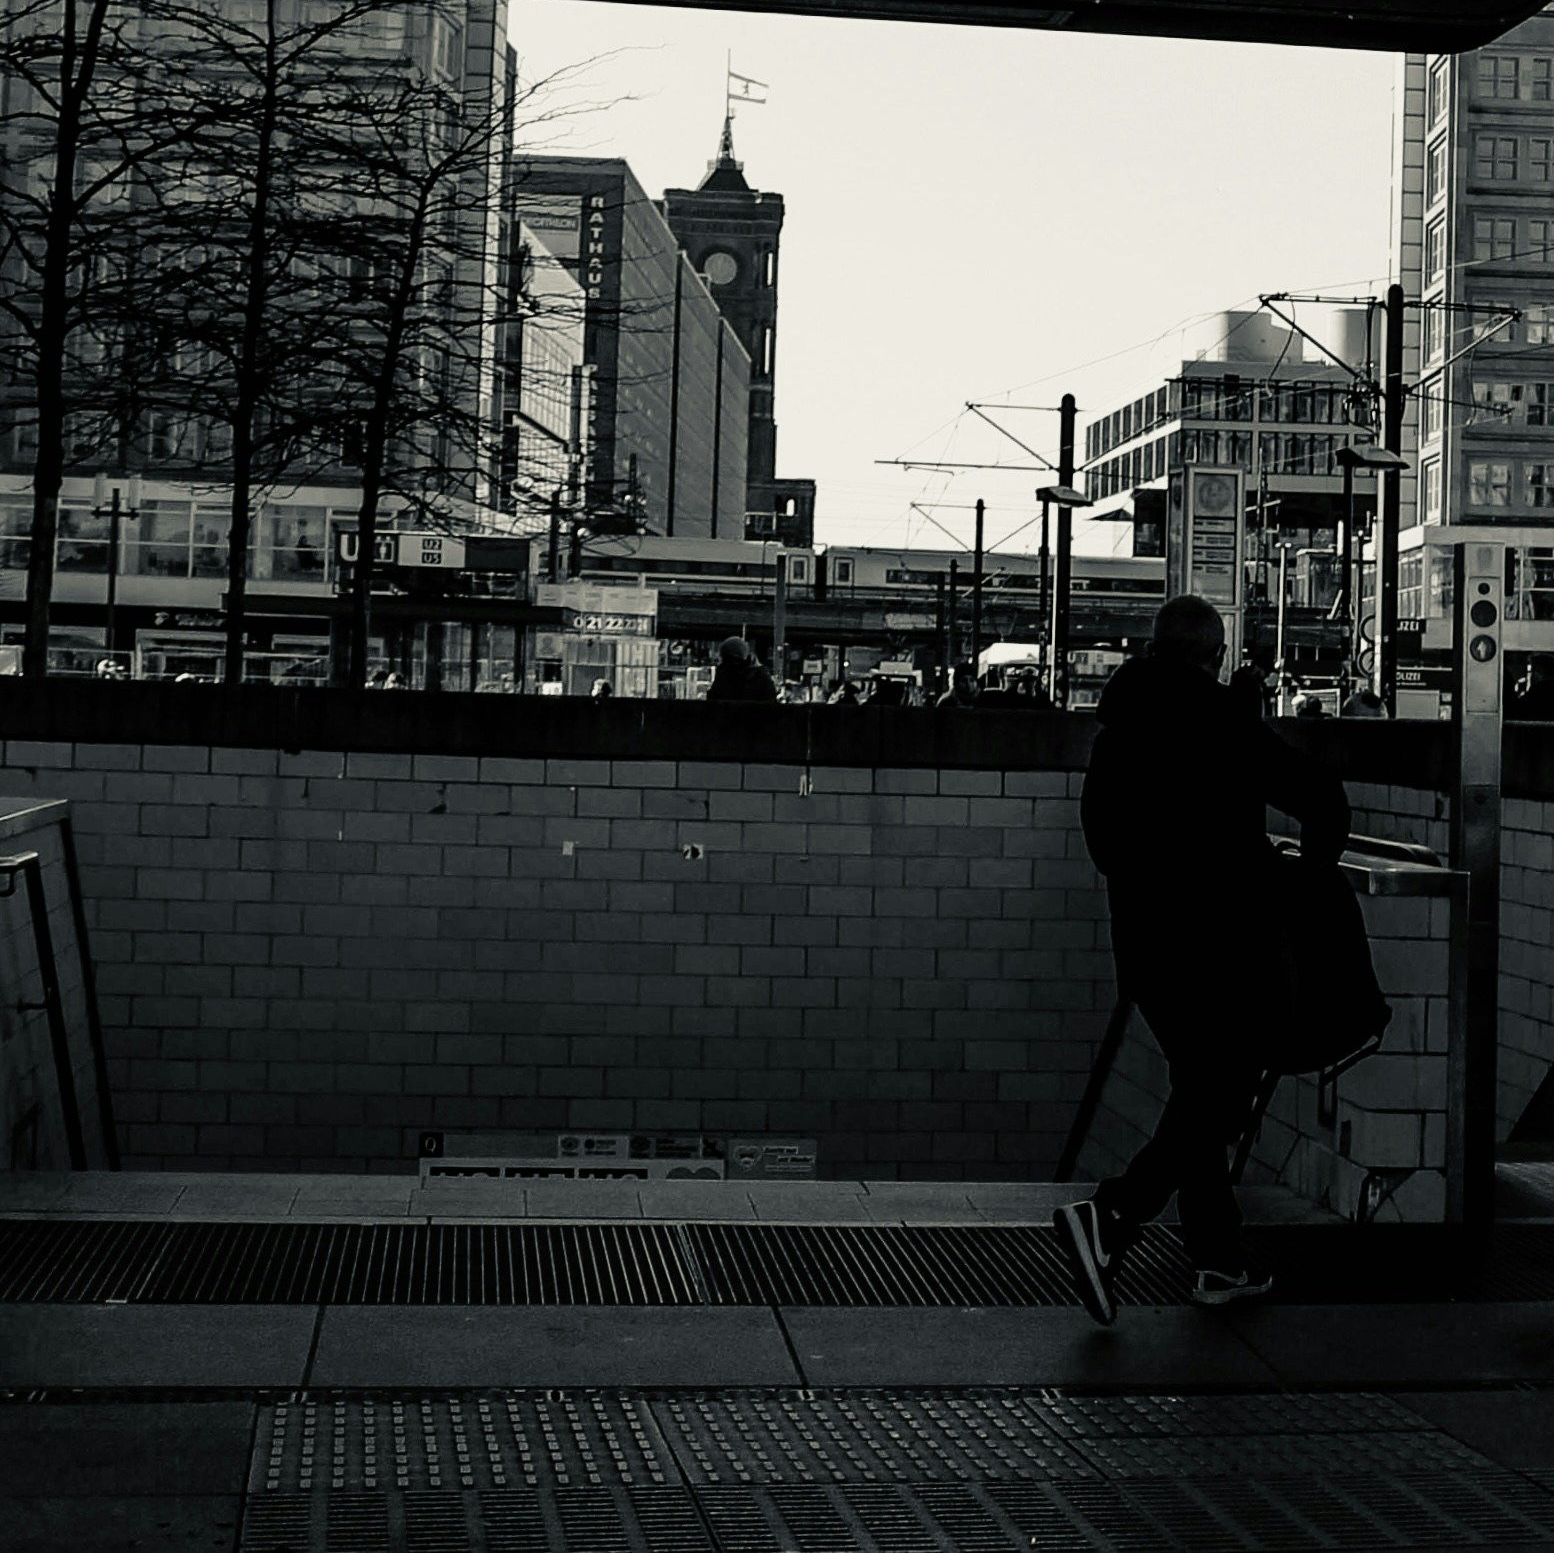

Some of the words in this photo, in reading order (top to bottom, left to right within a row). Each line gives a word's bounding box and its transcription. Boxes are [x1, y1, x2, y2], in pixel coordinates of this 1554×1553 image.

[588, 196, 604, 299] RATHAUS
[339, 533, 360, 563] U
[424, 538, 441, 550] U2
